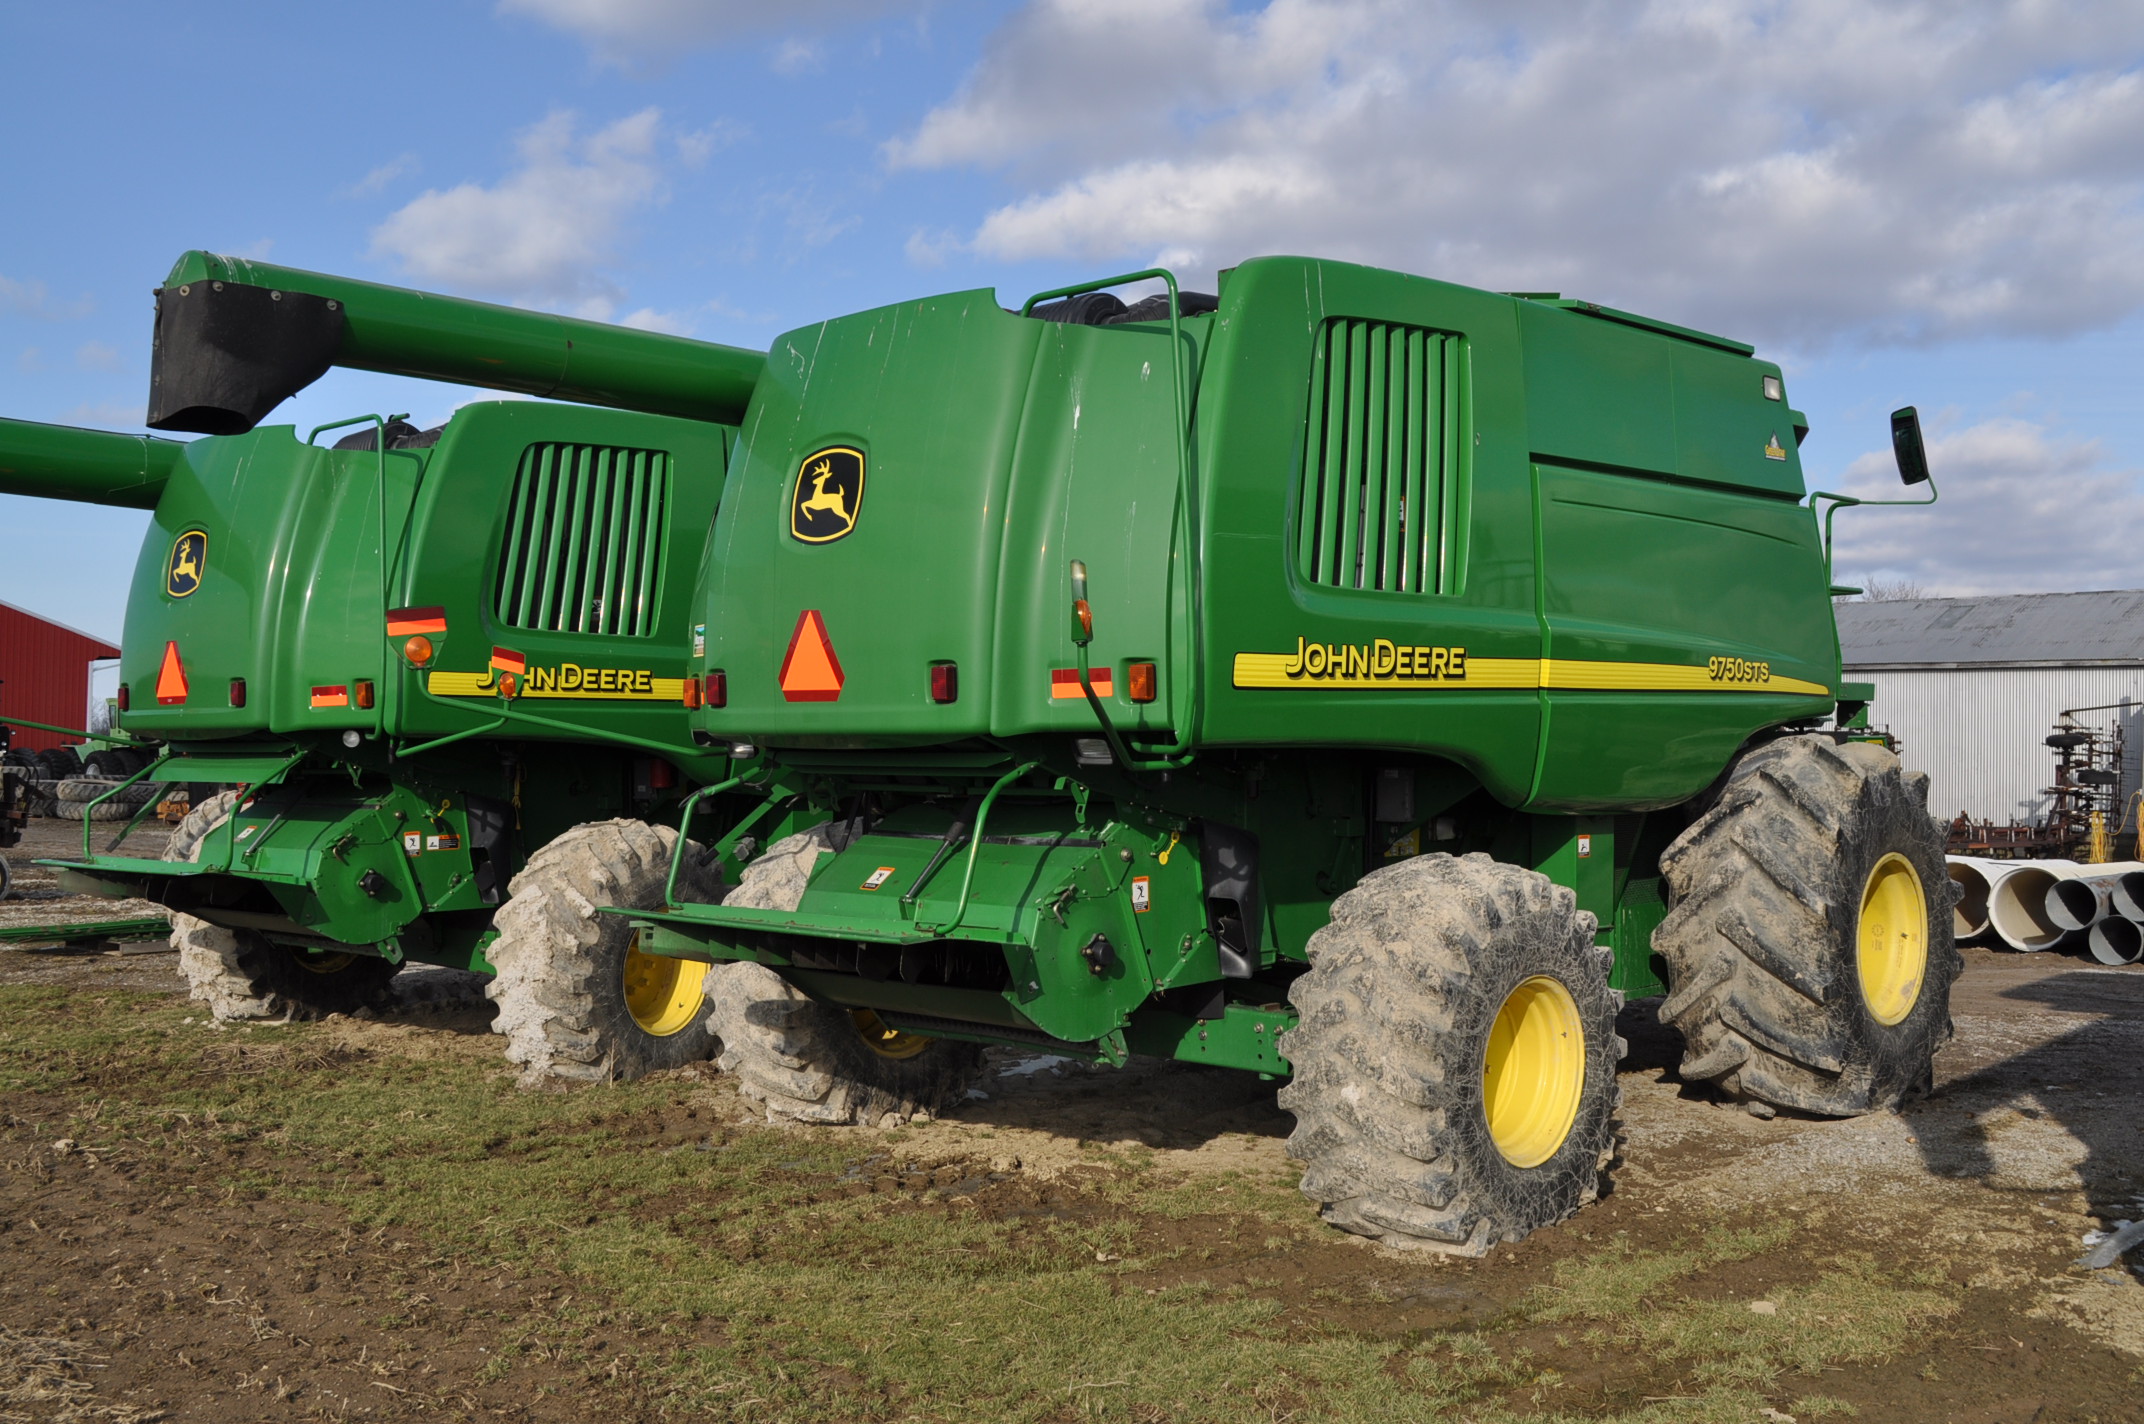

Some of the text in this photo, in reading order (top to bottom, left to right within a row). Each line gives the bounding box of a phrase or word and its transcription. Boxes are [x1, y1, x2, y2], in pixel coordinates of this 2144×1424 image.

[1285, 636, 1466, 679] JOHN DEERE
[1708, 656, 1770, 682] 9750STS
[476, 660, 652, 691] JHN DEERE
